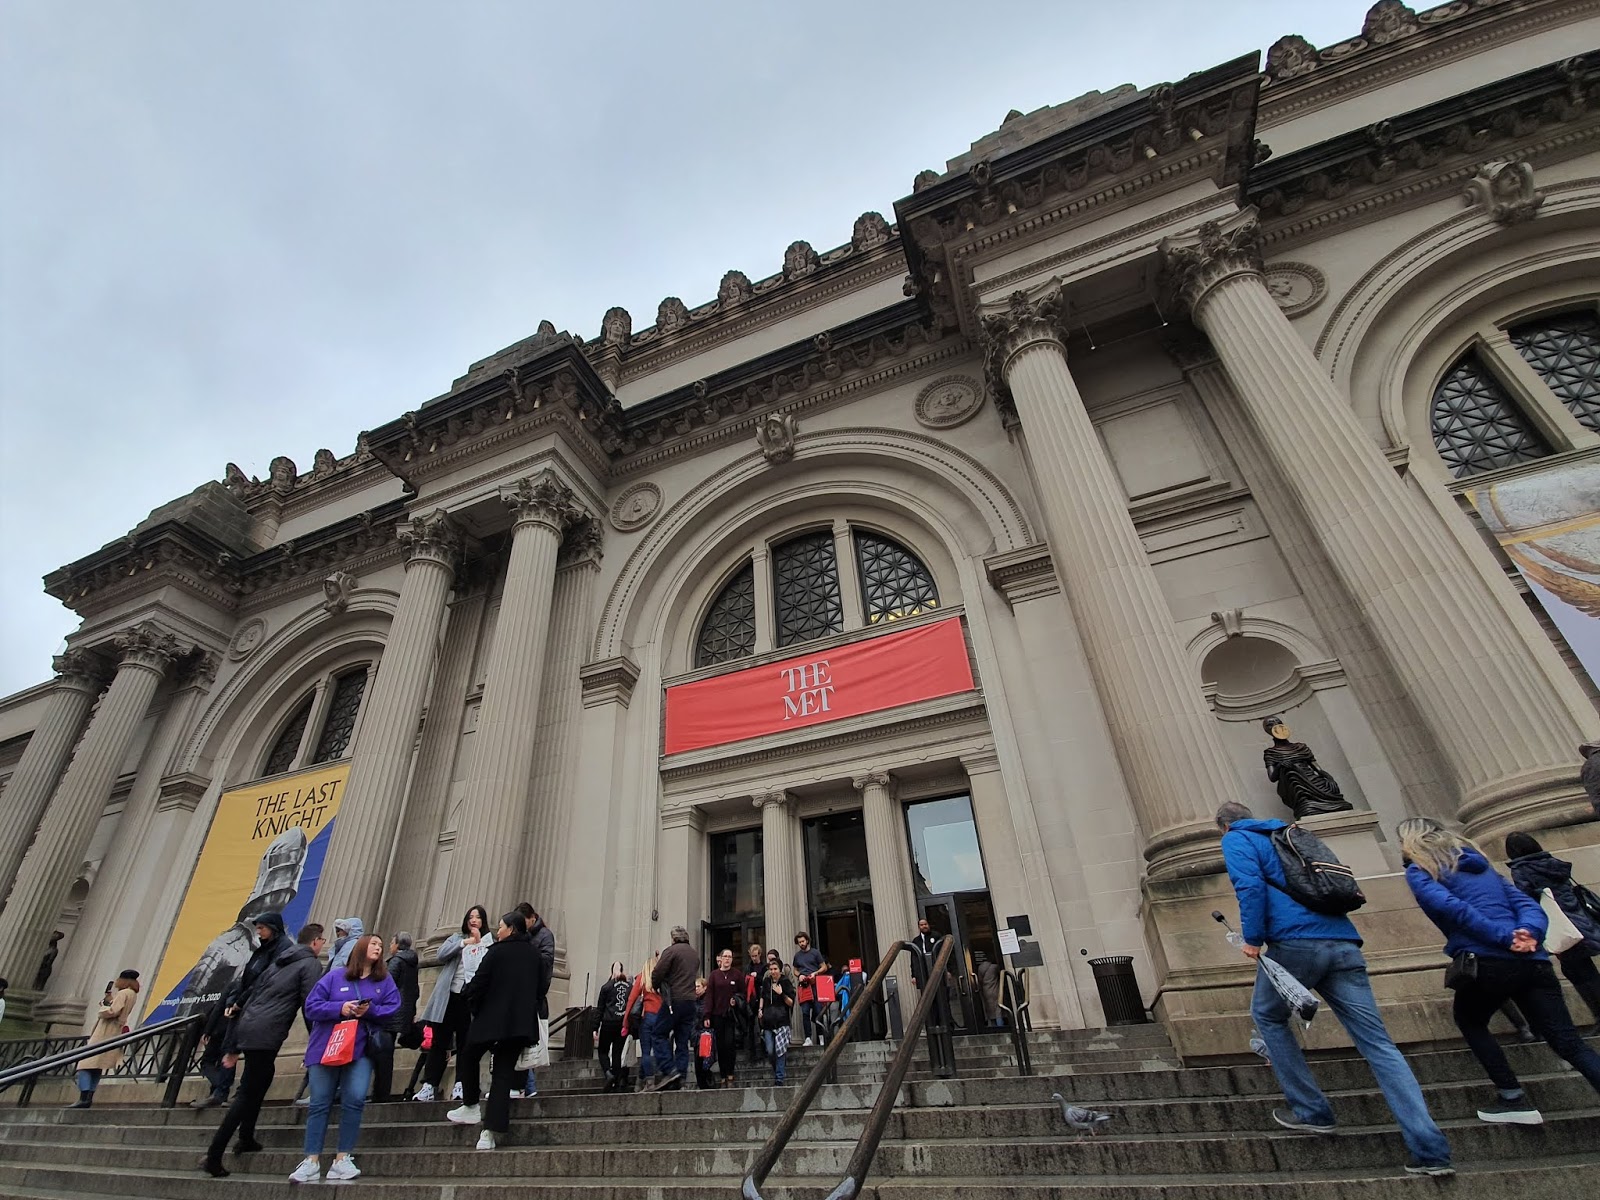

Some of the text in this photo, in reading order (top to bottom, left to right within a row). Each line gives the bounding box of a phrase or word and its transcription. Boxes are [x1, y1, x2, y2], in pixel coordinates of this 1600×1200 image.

[781, 660, 832, 692] THE
[781, 685, 835, 720] MET
[256, 780, 342, 817] THE LAST
[252, 805, 328, 840] KNIGHT
[180, 996, 201, 1004] January
[206, 992, 221, 1002] 2020
